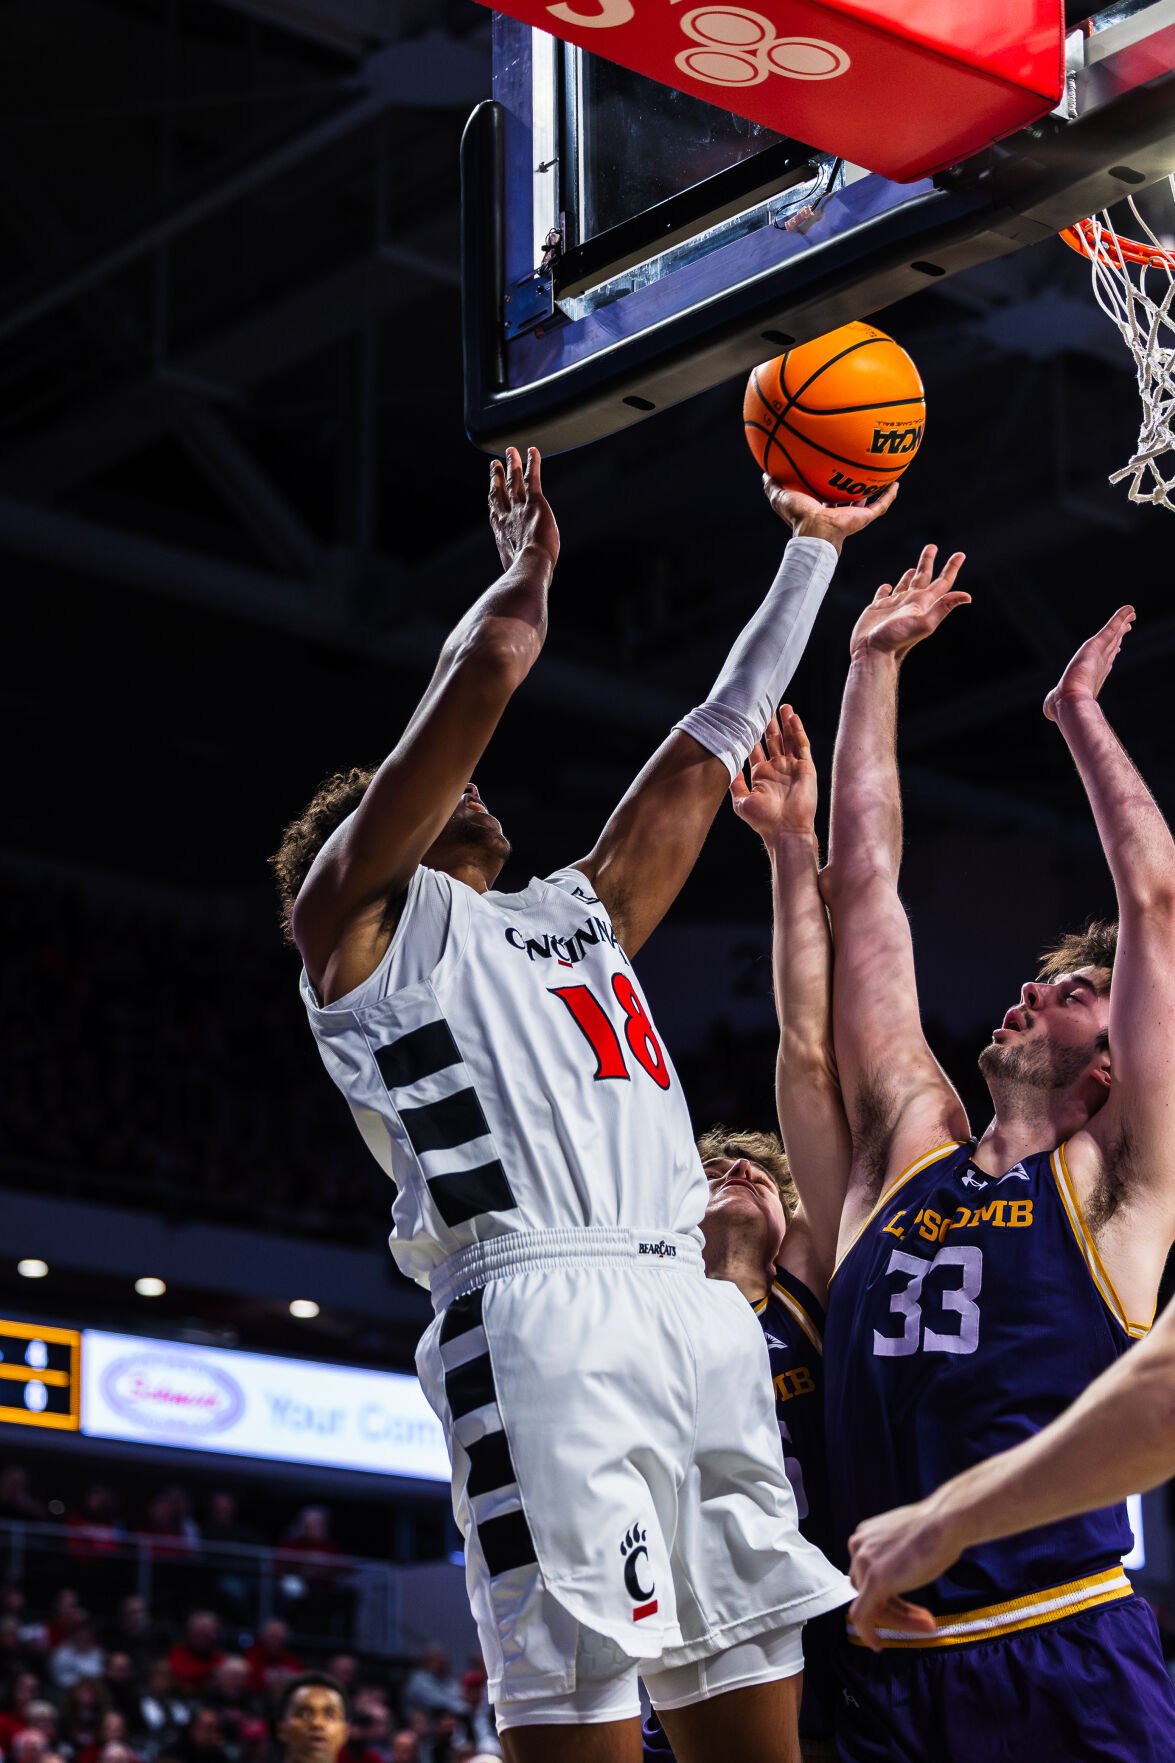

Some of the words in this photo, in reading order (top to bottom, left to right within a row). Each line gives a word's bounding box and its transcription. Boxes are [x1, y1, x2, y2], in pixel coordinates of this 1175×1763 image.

[546, 972, 670, 1091] 18
[638, 1242, 677, 1257] BEARCATS
[873, 1246, 983, 1356] 33
